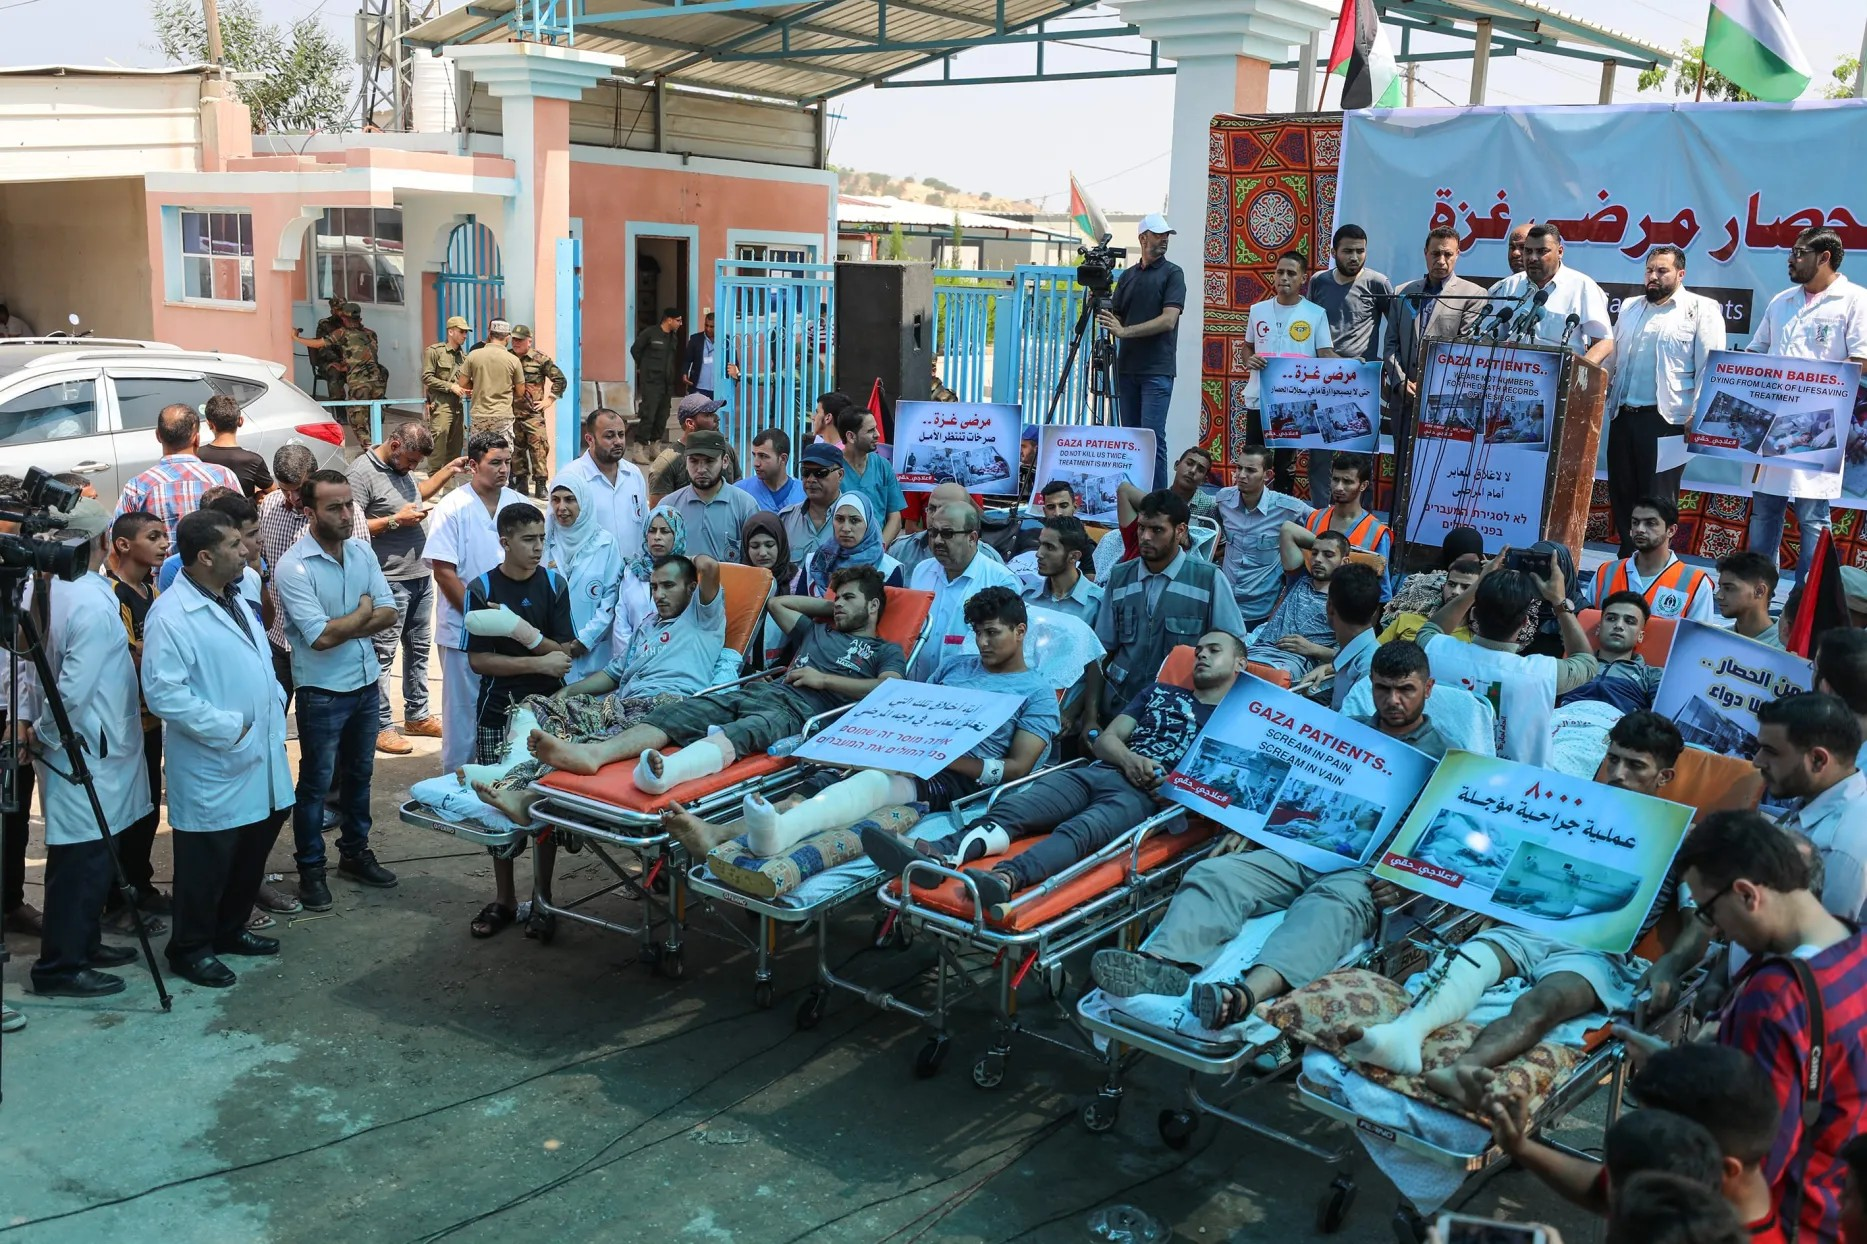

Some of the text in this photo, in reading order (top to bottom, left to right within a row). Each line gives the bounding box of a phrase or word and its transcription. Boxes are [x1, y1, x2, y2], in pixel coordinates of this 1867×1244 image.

[1429, 188, 1512, 252] غزة
[1708, 190, 1867, 264] حصار
[1437, 354, 1471, 367] GAZA
[1322, 365, 1357, 384] مرضى
[1454, 371, 1534, 387] WE ARE NOT NUMBERS
[1716, 363, 1783, 380] NEWBORN
[1446, 379, 1539, 397] FOR THE DEATH RECORDS
[1710, 376, 1849, 398] DYING FROM LACK OF LIFESAVING
[1749, 390, 1800, 403] TREATMENT
[960, 413, 991, 429] مرضى
[943, 431, 965, 443] تنتظر
[1056, 439, 1082, 448] GAZA
[1059, 459, 1094, 467] TREATMENT
[1112, 462, 1132, 470] RIGHT
[1486, 486, 1504, 501] أمام
[1424, 503, 1527, 525] לא לסגירת המעברים
[1481, 525, 1503, 536] בפני
[1708, 686, 1744, 708] دواء
[1773, 678, 1802, 698] من
[1248, 700, 1294, 731] GAZA
[863, 743, 885, 753] את
[923, 737, 953, 746] איזה
[1266, 728, 1311, 757] SCREAM
[1311, 747, 1323, 760] IN
[1258, 741, 1346, 787] SCREAM IN VAIN
[1524, 780, 1583, 807] ٨٠٠٠
[1457, 785, 1637, 850] عملية جراحية مؤجلة
[1809, 1045, 1821, 1090] Canon
